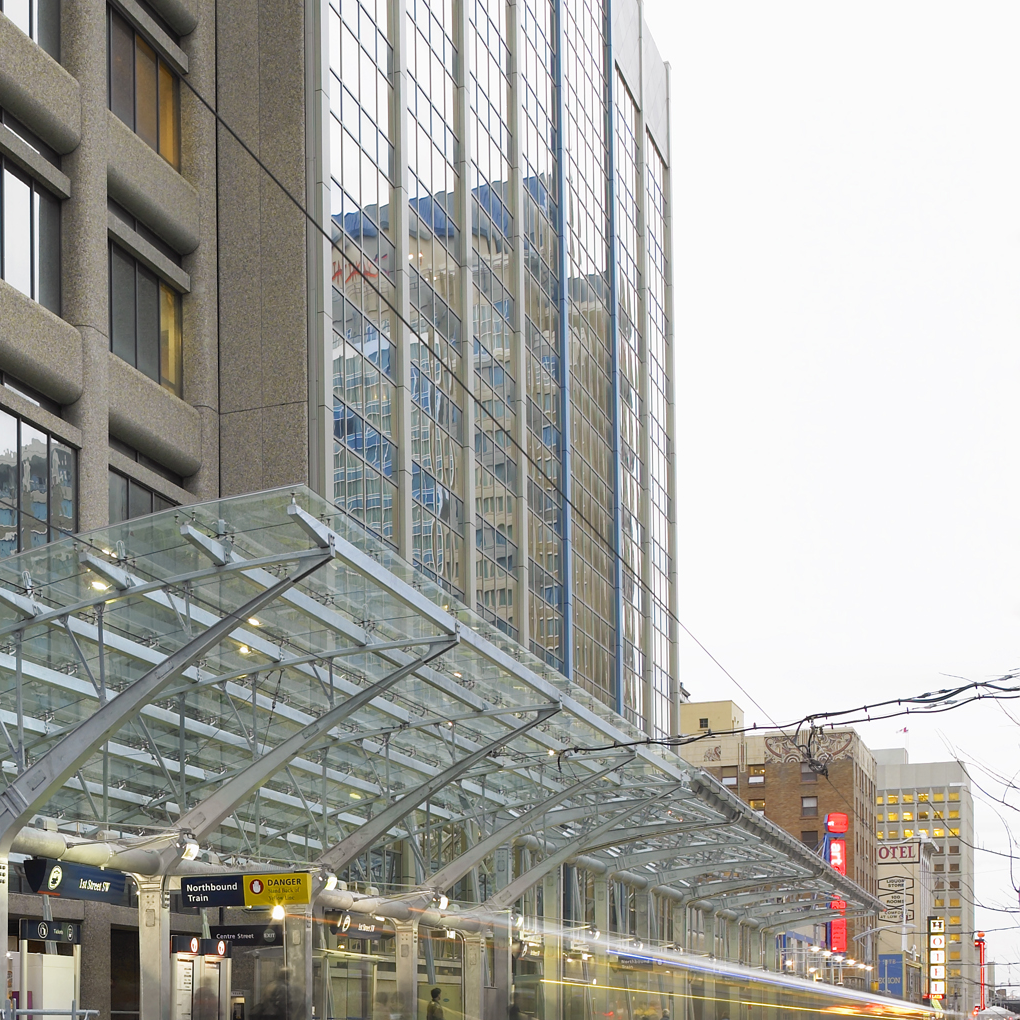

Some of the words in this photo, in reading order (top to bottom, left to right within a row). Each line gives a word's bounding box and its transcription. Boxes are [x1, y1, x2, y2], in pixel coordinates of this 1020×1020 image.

[878, 846, 916, 860] OTEL
[79, 878, 87, 889] 1st
[87, 880, 102, 891] Street
[102, 882, 111, 892] SW
[186, 882, 238, 892] Northbound
[267, 878, 302, 886] DANGER
[187, 894, 209, 902] Train
